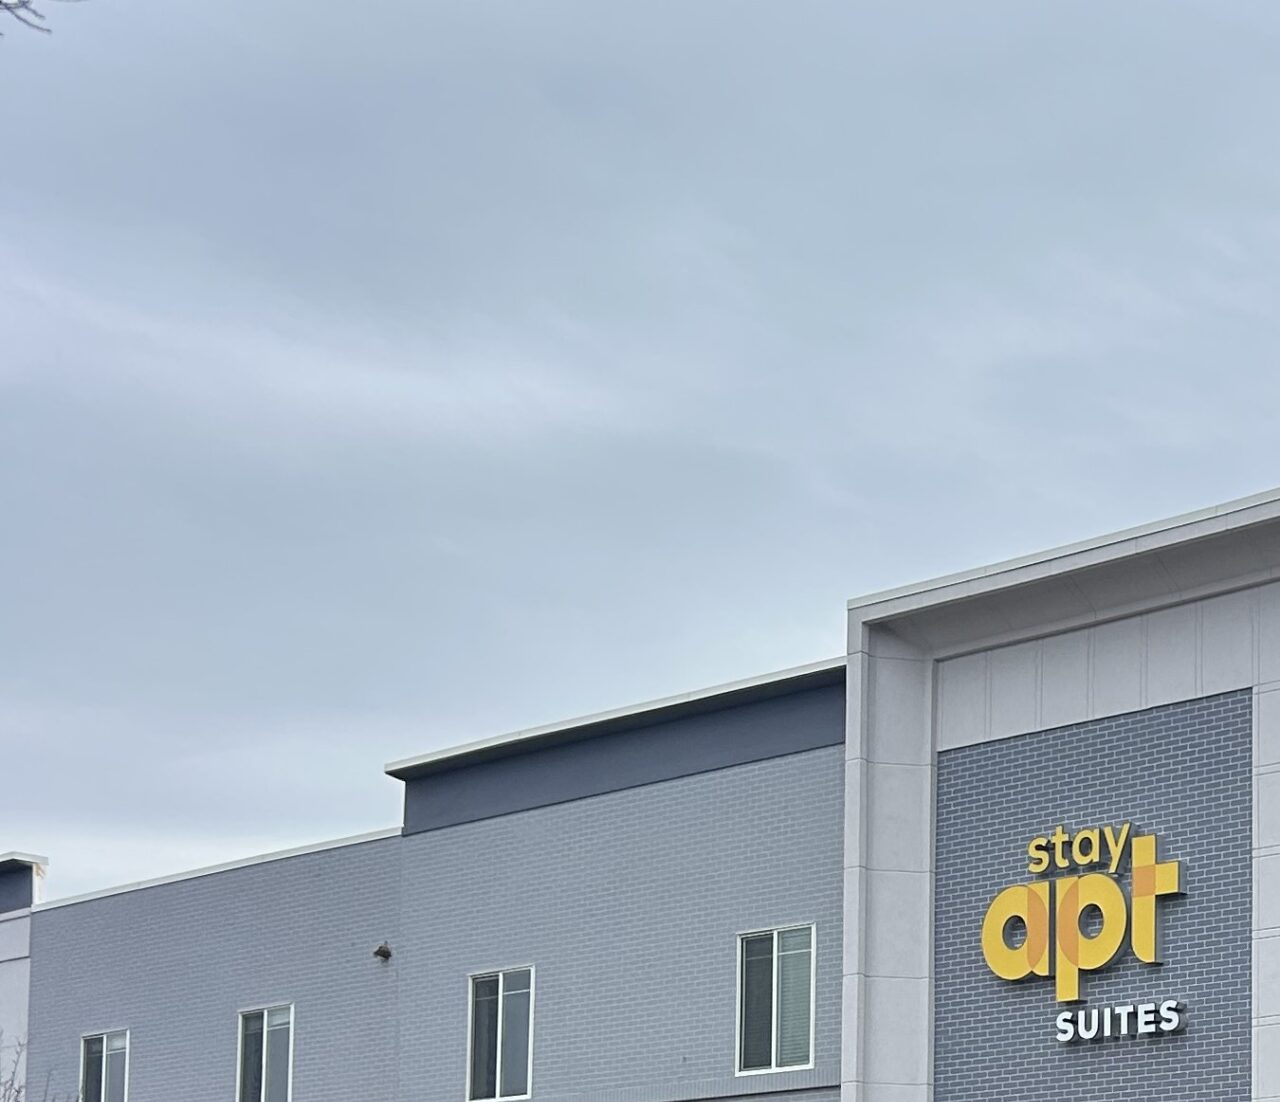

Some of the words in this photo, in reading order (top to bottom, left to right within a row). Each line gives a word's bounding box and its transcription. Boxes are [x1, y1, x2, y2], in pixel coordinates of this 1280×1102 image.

[1028, 821, 1132, 875] stay
[981, 833, 1181, 1002] apt
[1055, 999, 1181, 1042] SUITES
